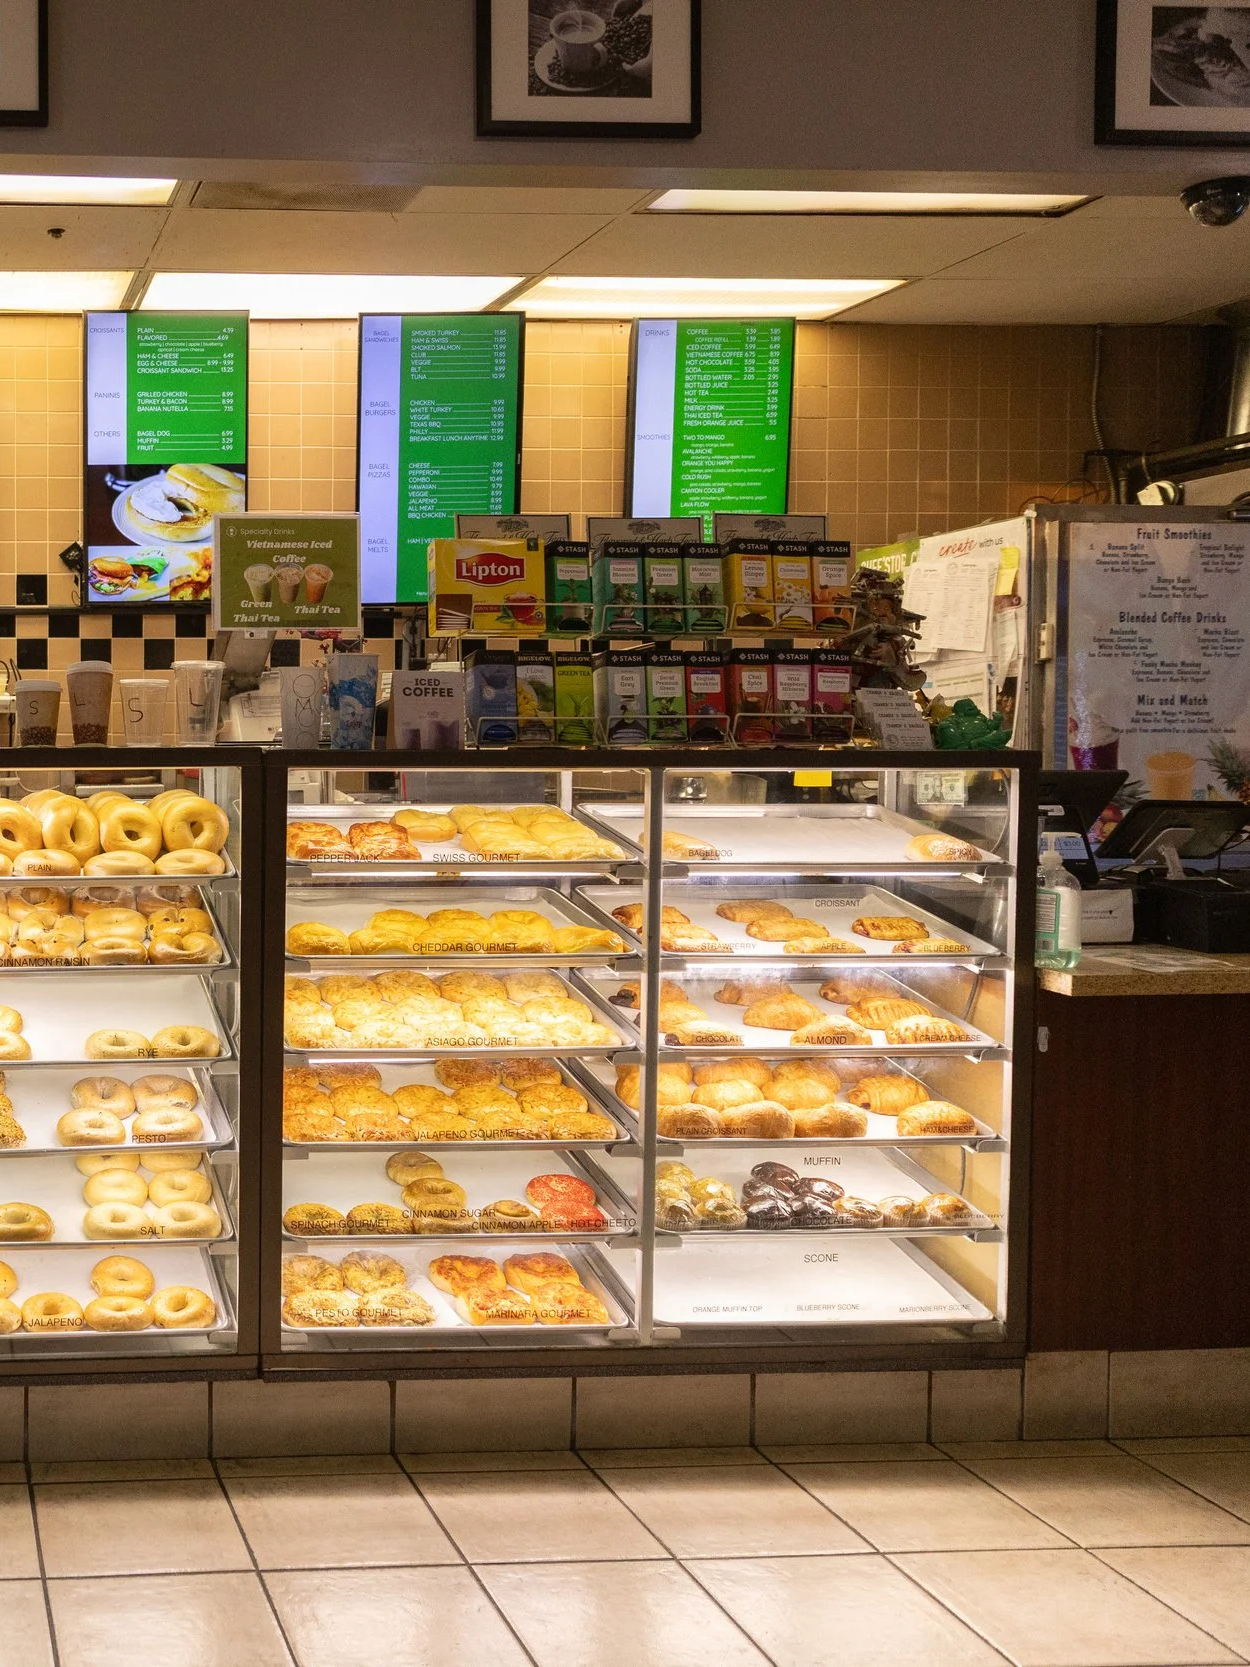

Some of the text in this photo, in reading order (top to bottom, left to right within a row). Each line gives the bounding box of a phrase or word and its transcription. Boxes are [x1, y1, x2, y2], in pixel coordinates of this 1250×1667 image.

[240, 528, 272, 537] Specialty
[1137, 528, 1212, 539] Fruit Smoothies
[247, 540, 332, 549] Vietnamese Iced
[939, 538, 977, 556] create
[979, 539, 993, 548] with
[273, 554, 306, 563] Coffee
[462, 562, 520, 580] Lipton
[241, 600, 272, 608] Green
[294, 605, 340, 614] Thai Tea
[234, 614, 280, 623] Thai Tea
[1119, 611, 1227, 623] Blended Coffee Drinks
[786, 653, 809, 661] STASH
[414, 678, 440, 687] ICED
[403, 687, 454, 697] COFFEE
[189, 688, 203, 706] L
[1138, 695, 1208, 706] Mix and Match
[30, 700, 39, 715] S
[128, 698, 144, 722] S
[310, 854, 380, 863] PEPPER JACK
[433, 854, 520, 862] SWISS GOURMET
[28, 864, 52, 872] PLAIN
[815, 899, 860, 908] CROISSANT
[413, 942, 518, 952] CHEDDAR GOURMET
[821, 941, 846, 950] APPLE
[56, 958, 90, 967] RAISIN
[426, 1036, 518, 1047] ASIAGO GOURMET
[696, 1034, 744, 1043] CHOCOLATE
[804, 1035, 847, 1044] ALMOND
[138, 1048, 159, 1057] RYE
[676, 1127, 747, 1135] PLAIN CROISSANT
[919, 1126, 974, 1134] HAM&CHEESE
[132, 1134, 166, 1143] PESTO
[804, 1157, 841, 1166] MUFFIN
[402, 1208, 496, 1219] CINNAMON SUGAR
[291, 1219, 390, 1229] SPINACH GOURMET
[472, 1220, 561, 1230] CINNAMON APPLE
[570, 1219, 636, 1228] HOT CHEETO
[791, 1216, 852, 1225] CHOCOLATE
[140, 1226, 165, 1235] SALT
[804, 1254, 839, 1263] SCONE
[486, 1309, 591, 1319] MARINARA GOURMET
[29, 1317, 83, 1327] JALAPENO
